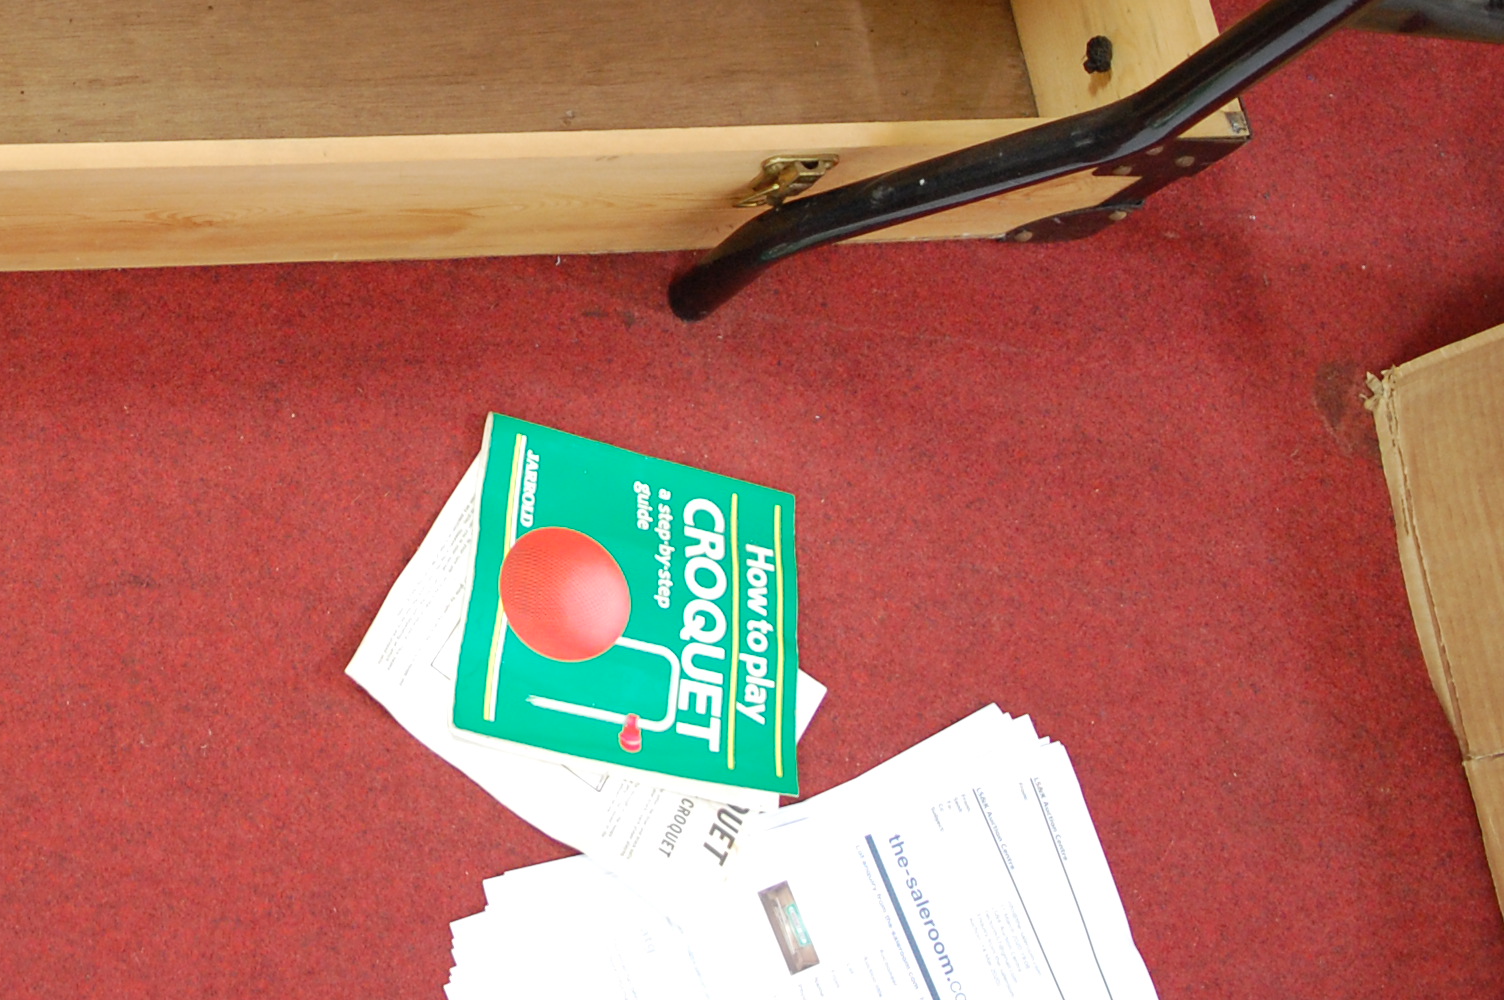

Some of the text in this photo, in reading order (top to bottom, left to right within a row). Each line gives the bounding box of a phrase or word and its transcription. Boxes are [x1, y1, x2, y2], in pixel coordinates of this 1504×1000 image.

[520, 448, 540, 528] JARROLD
[633, 480, 653, 530] guide
[653, 488, 675, 609] a step-by-step
[675, 497, 728, 753] CROQUET
[736, 543, 775, 725] How to play
[658, 797, 695, 858] CROQUET
[986, 811, 1003, 842] Auction
[1000, 843, 1015, 870] Centre
[1043, 801, 1058, 832] Auction
[1055, 834, 1068, 861] Centre
